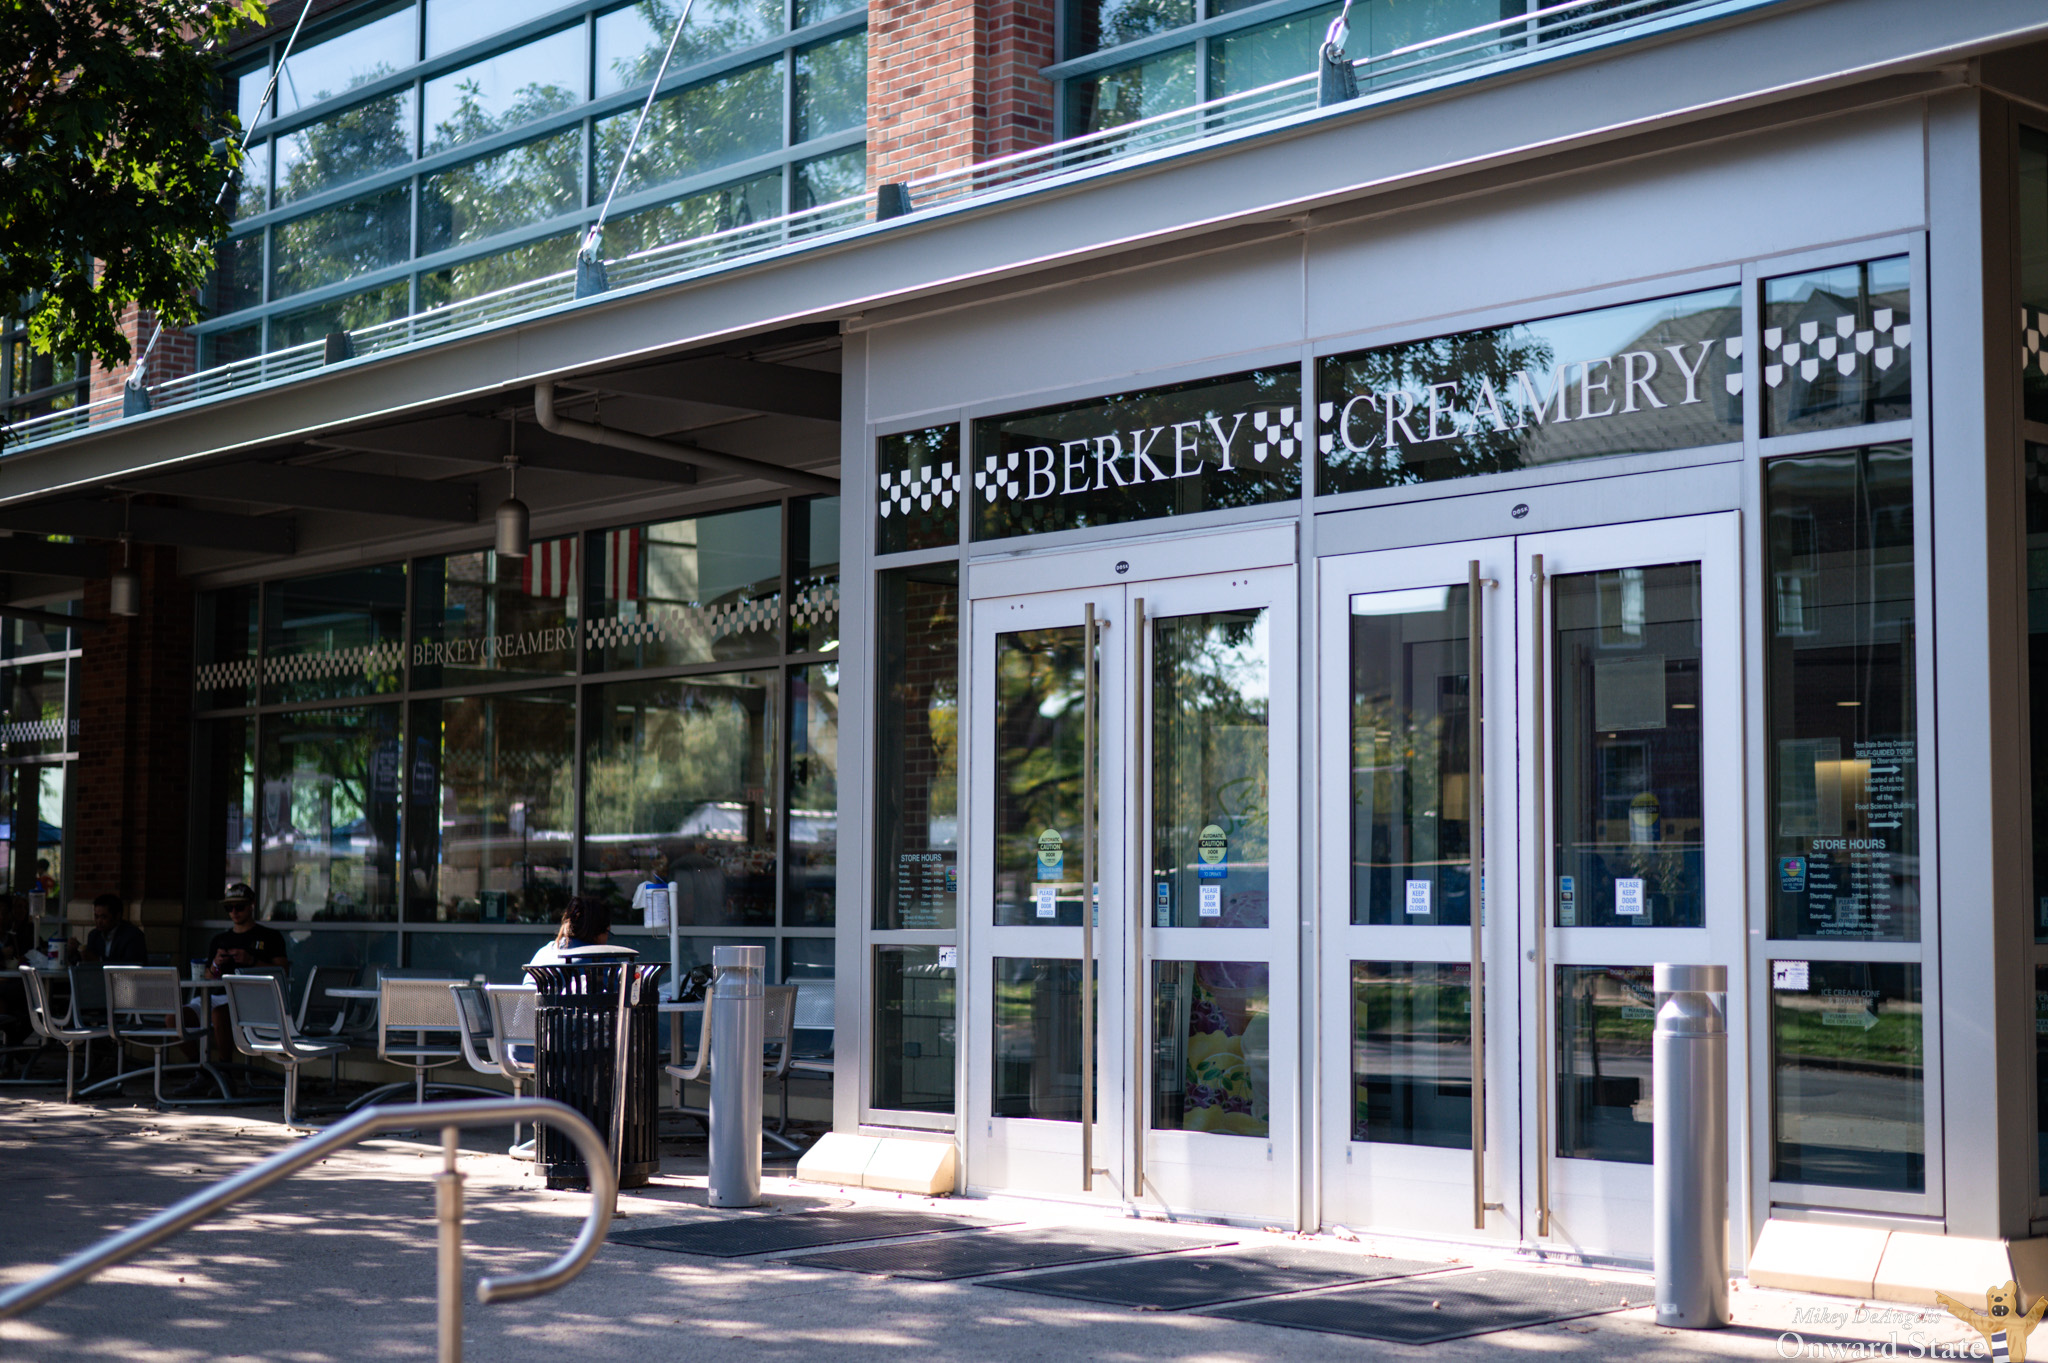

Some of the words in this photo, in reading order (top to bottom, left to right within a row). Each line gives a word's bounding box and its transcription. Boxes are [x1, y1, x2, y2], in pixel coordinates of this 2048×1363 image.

[1024, 412, 1247, 500] BERKEY
[1340, 340, 1716, 453] CREAMERY
[413, 639, 478, 666] BERKEY
[481, 626, 578, 659] CREAMERY
[1813, 840, 1846, 849] STORE
[1849, 839, 1886, 849] HOURS
